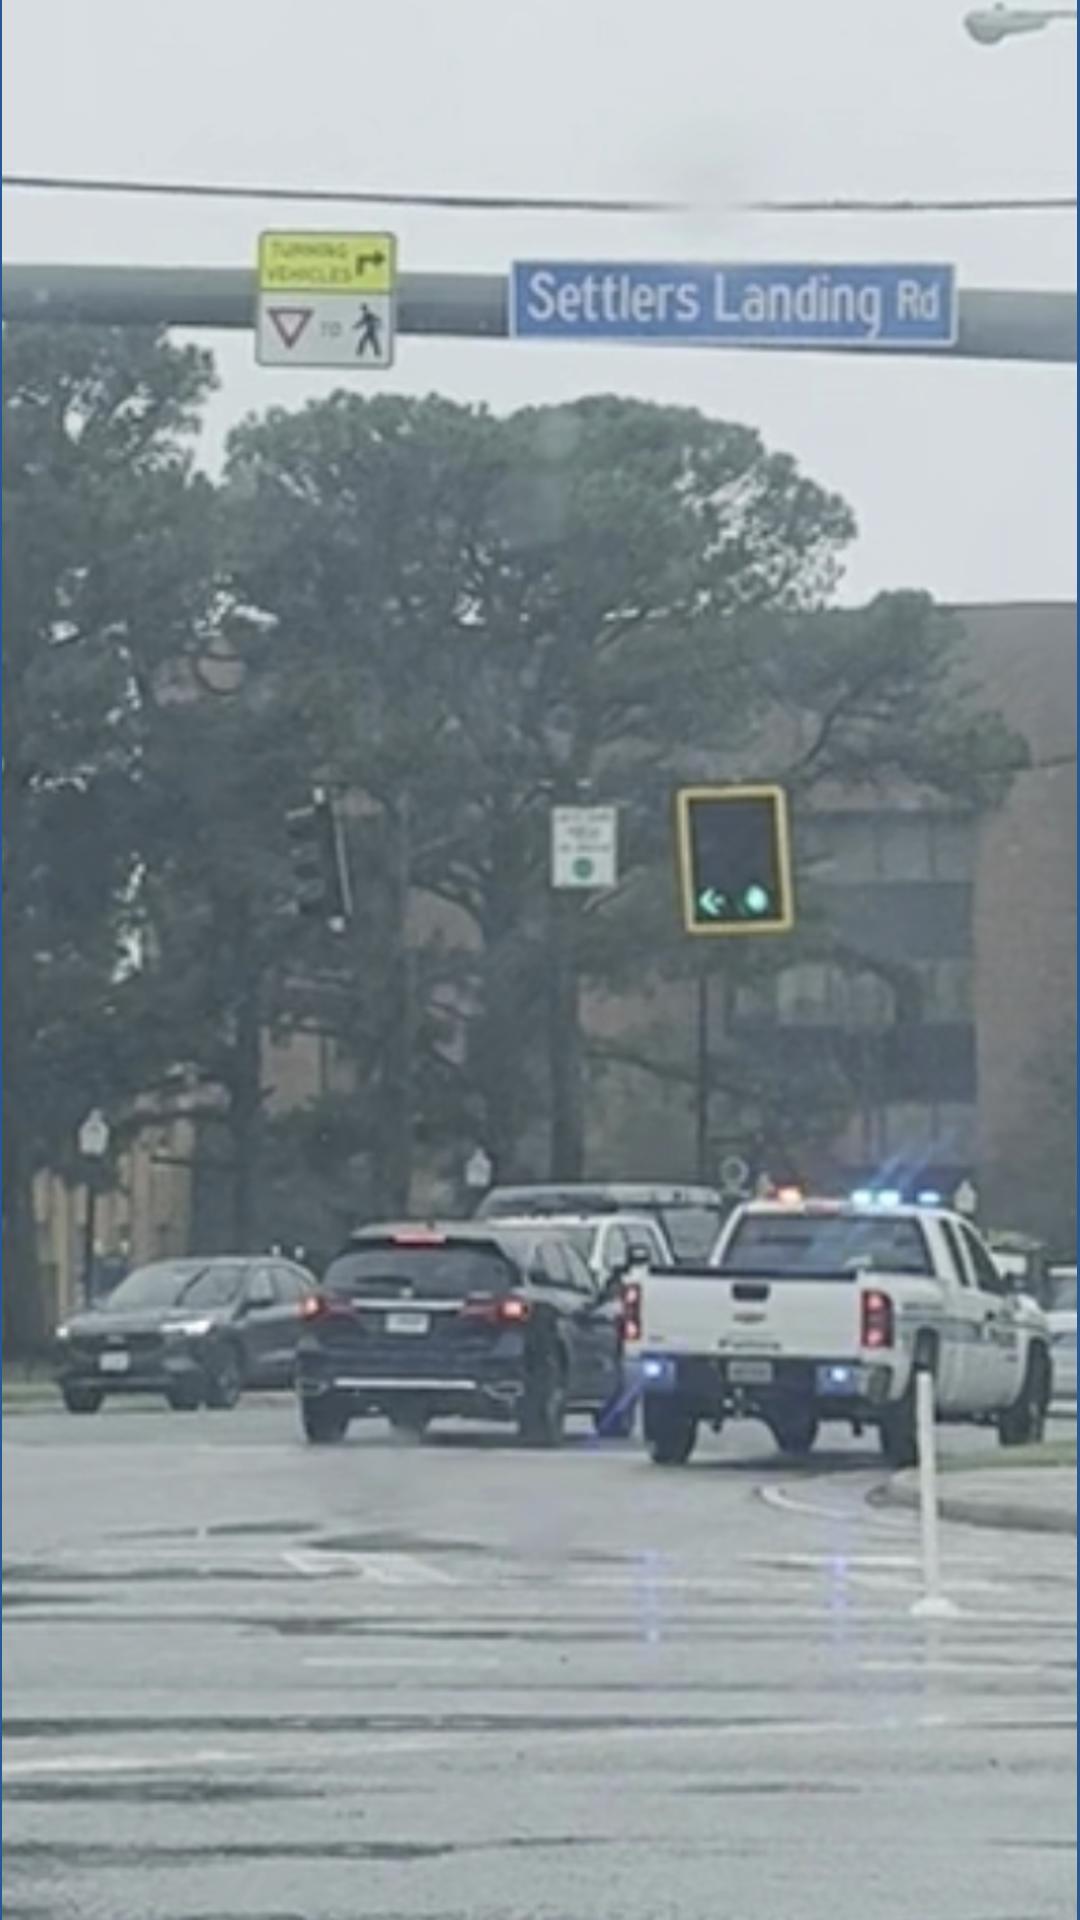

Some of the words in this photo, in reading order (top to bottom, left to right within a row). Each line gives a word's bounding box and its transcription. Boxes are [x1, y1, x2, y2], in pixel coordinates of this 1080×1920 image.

[527, 271, 700, 322] Settlers
[714, 272, 881, 341] Landing
[897, 279, 940, 320] Rd
